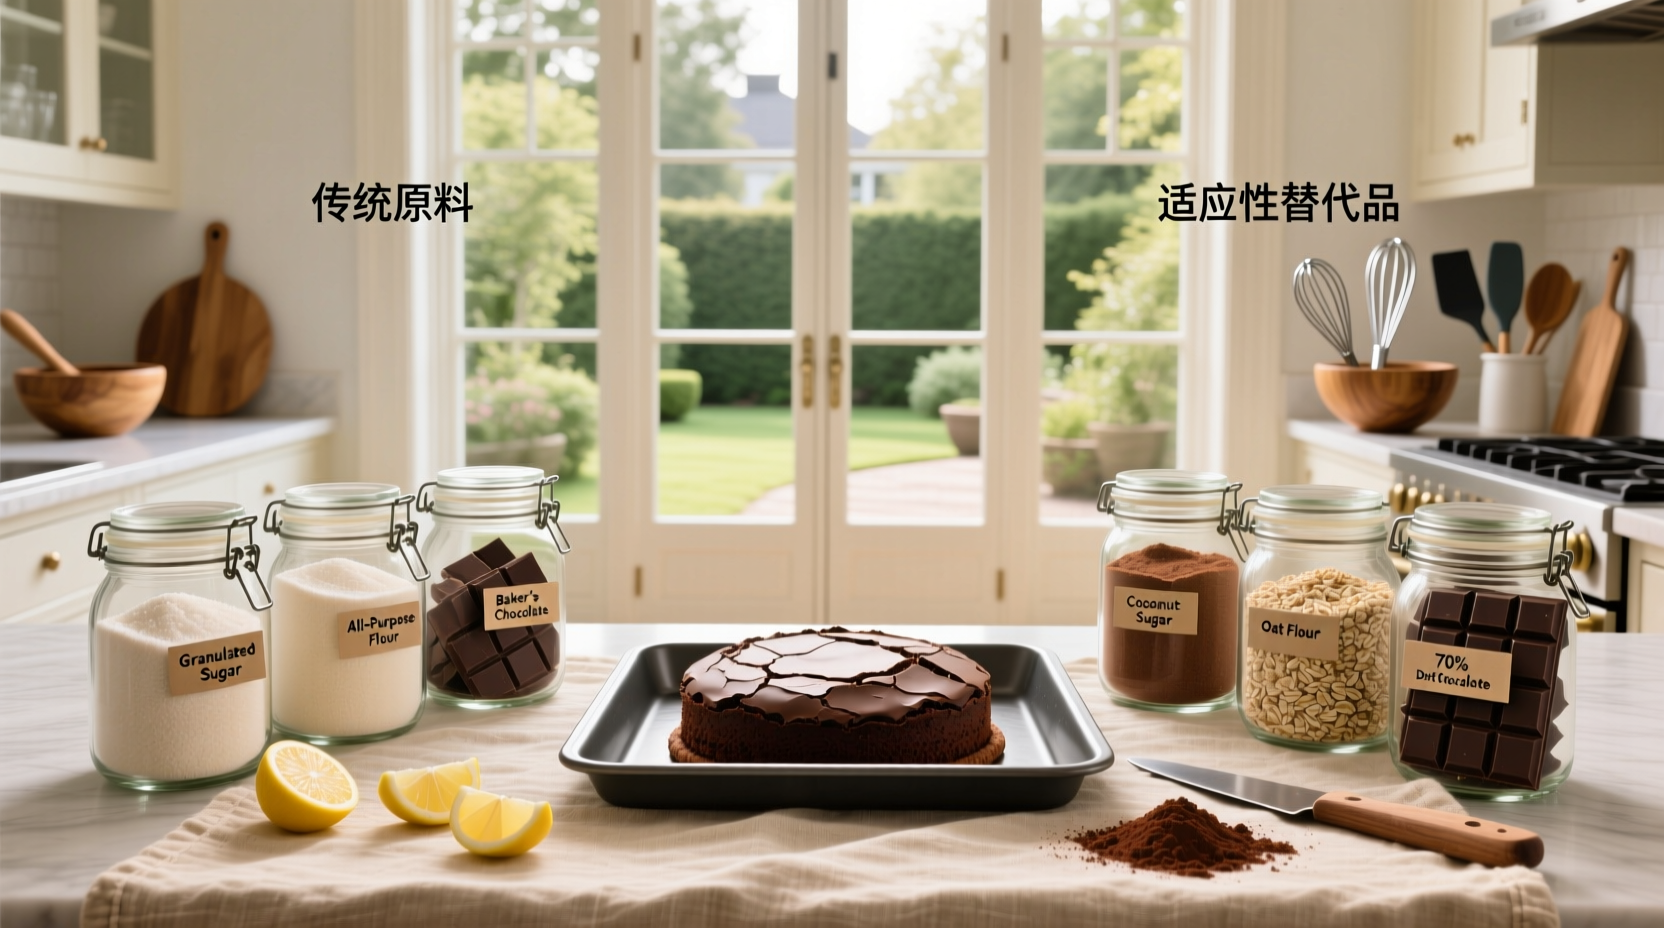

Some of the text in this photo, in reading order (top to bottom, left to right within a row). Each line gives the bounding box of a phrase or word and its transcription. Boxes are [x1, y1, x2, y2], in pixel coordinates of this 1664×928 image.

[1126, 595, 1181, 610] Coconut
[495, 605, 549, 620] Chocolate
[1136, 611, 1173, 628] Sugar
[347, 614, 415, 633] All-Purpose
[1261, 620, 1321, 639] Oat Flour
[369, 632, 399, 647] Flour
[179, 642, 256, 667] Granulated
[1435, 652, 1468, 671] 70%
[200, 665, 242, 682] Sugar
